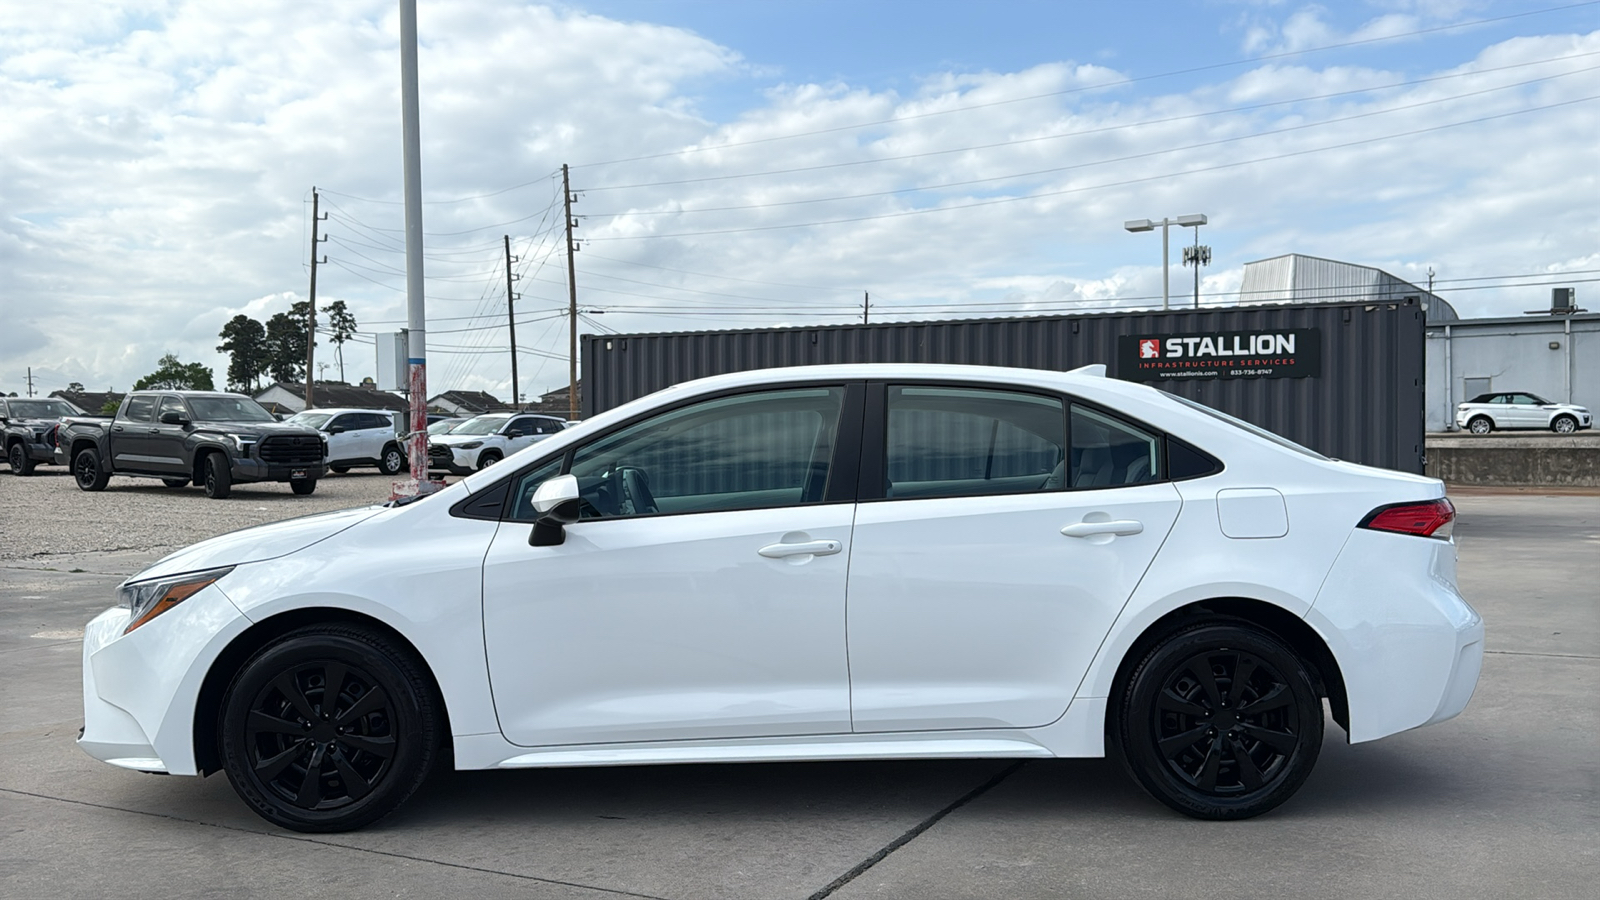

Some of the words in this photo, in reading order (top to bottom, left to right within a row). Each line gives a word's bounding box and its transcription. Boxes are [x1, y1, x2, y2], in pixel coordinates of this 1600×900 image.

[1165, 333, 1295, 358] STALLION
[1139, 360, 1234, 369] INFRASTRUCTURE
[1240, 358, 1295, 366] SERVICES
